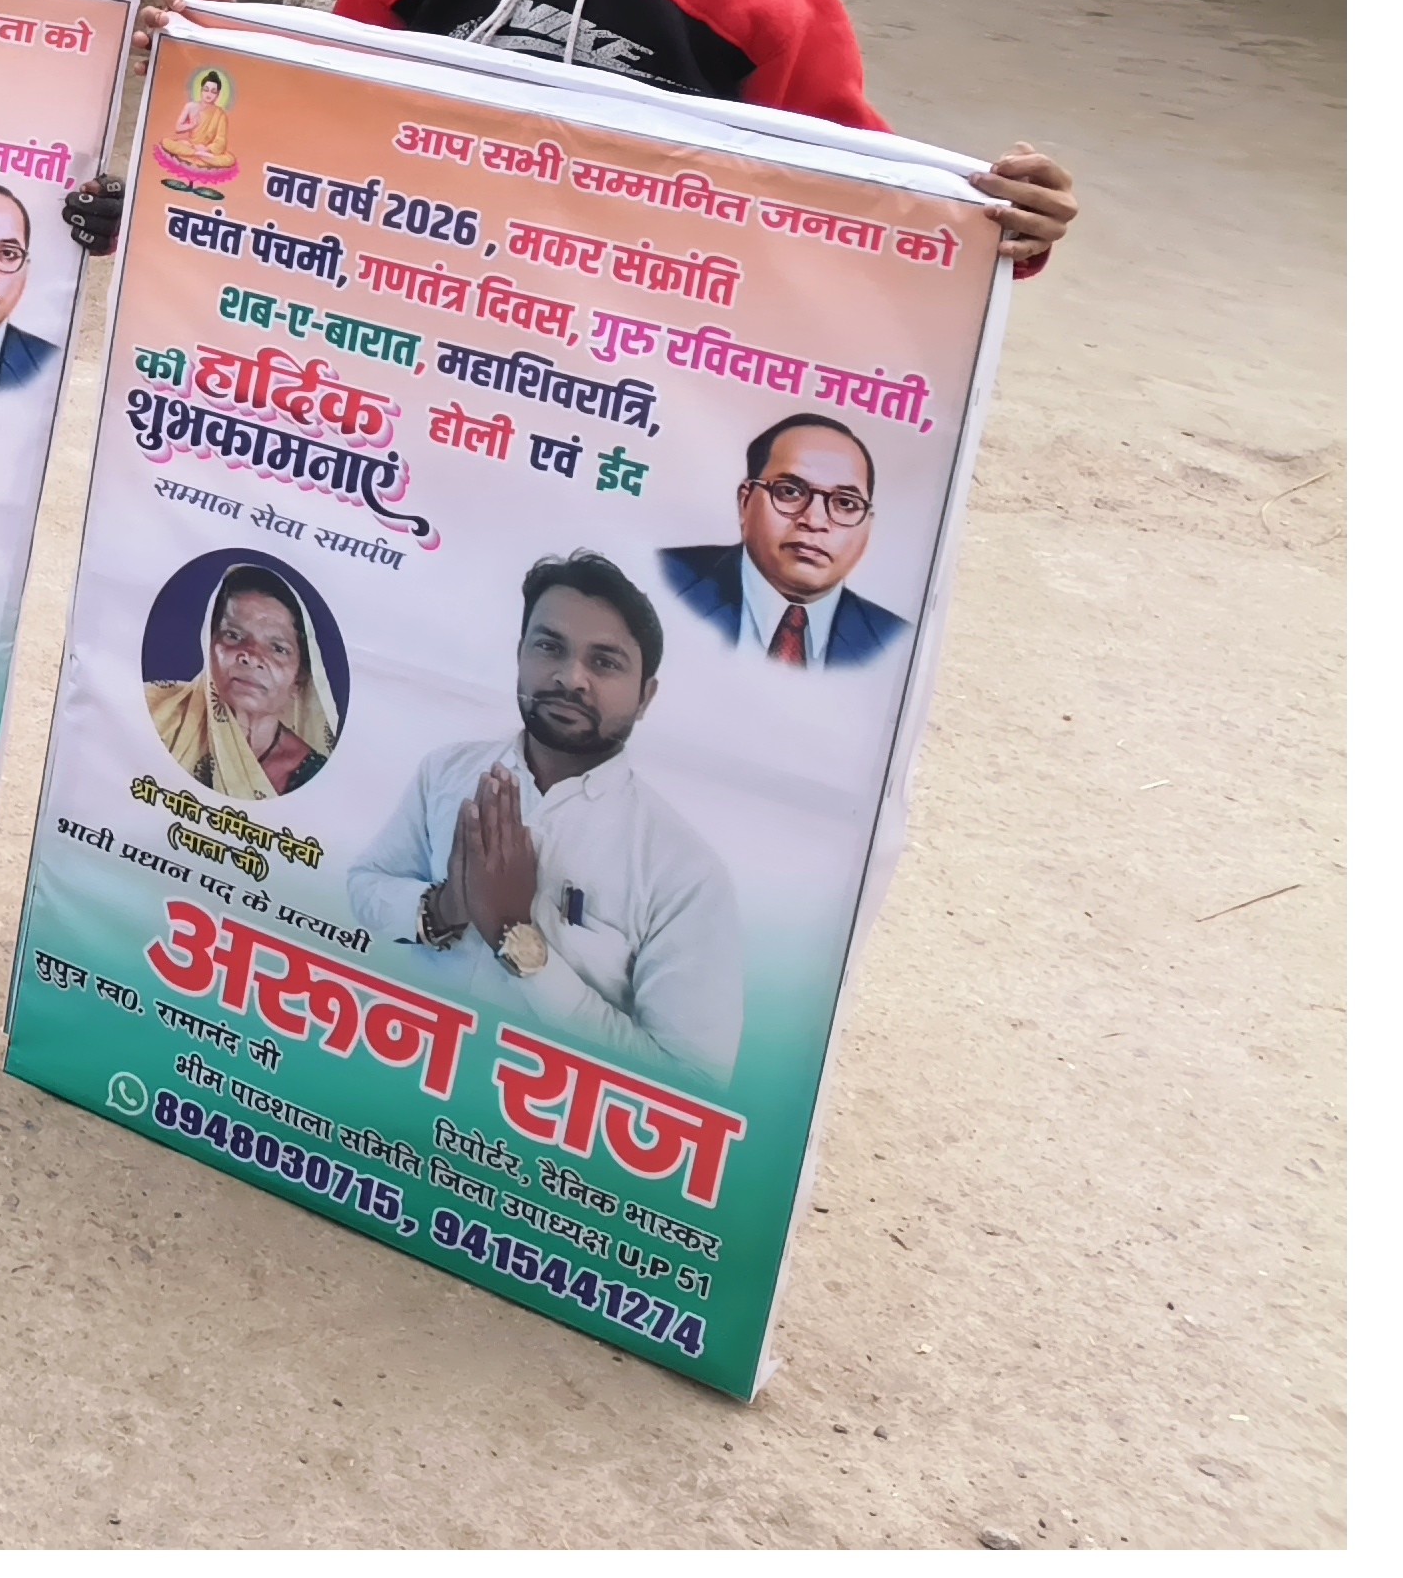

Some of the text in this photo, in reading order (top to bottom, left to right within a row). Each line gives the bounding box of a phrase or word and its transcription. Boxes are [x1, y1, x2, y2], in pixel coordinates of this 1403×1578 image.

[44, 20, 93, 52] को
[266, 165, 323, 209] नव
[327, 179, 381, 222] वर्ष
[509, 221, 608, 275] मकर
[612, 241, 740, 306] संक्रांति
[134, 344, 390, 449] की हार्दिक
[168, 206, 933, 433] बसंत पंचमी, गणतंत्र दिवस, गुरु रविदास जयंती,
[125, 389, 430, 537] शुभकामनाएं
[176, 1054, 224, 1093] भीम
[231, 1079, 331, 1140] पाठशाला
[340, 1127, 421, 1176] समिति
[430, 1157, 495, 1207] जिला
[503, 1194, 609, 1255] उपाध्यक्ष
[678, 1267, 709, 1297] 51
[499, 1031, 742, 1202] राज
[155, 1092, 701, 1354] 8948030715, 9415441274
